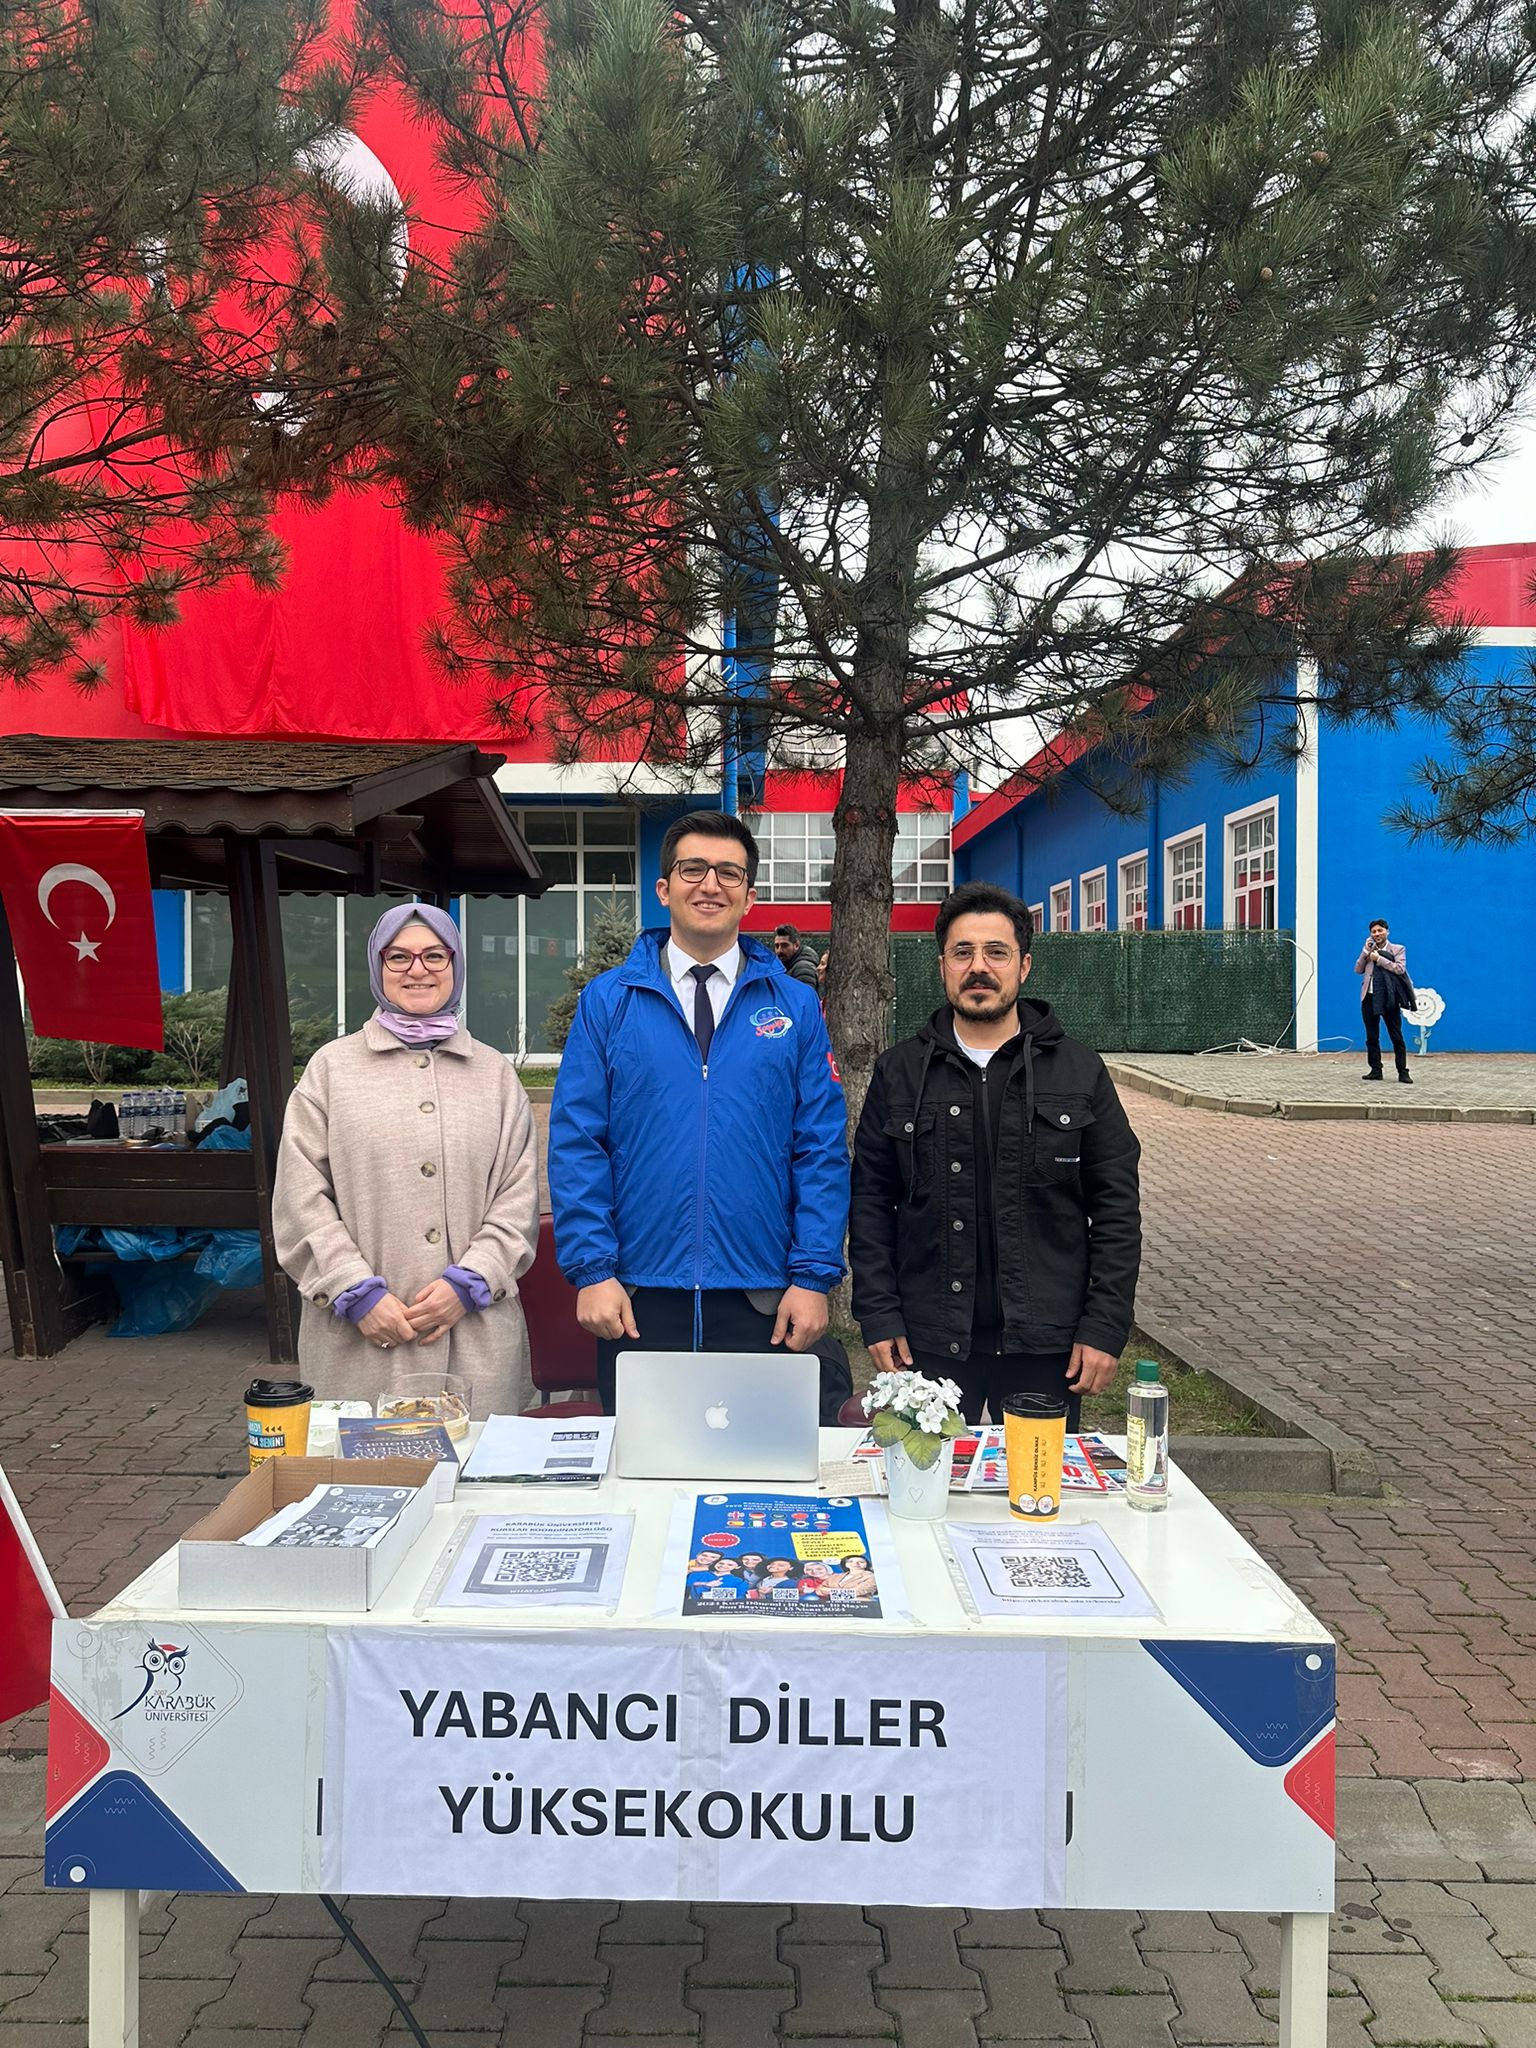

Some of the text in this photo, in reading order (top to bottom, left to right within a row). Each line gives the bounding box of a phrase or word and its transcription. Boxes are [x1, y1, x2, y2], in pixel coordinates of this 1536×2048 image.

[144, 1694, 216, 1710] KARABÜK
[145, 1710, 208, 1722] ÜNİVERSİTESİ
[399, 1682, 948, 1748] YABANCI DİLLER
[439, 1772, 916, 1844] YÜKSEKOKULU
